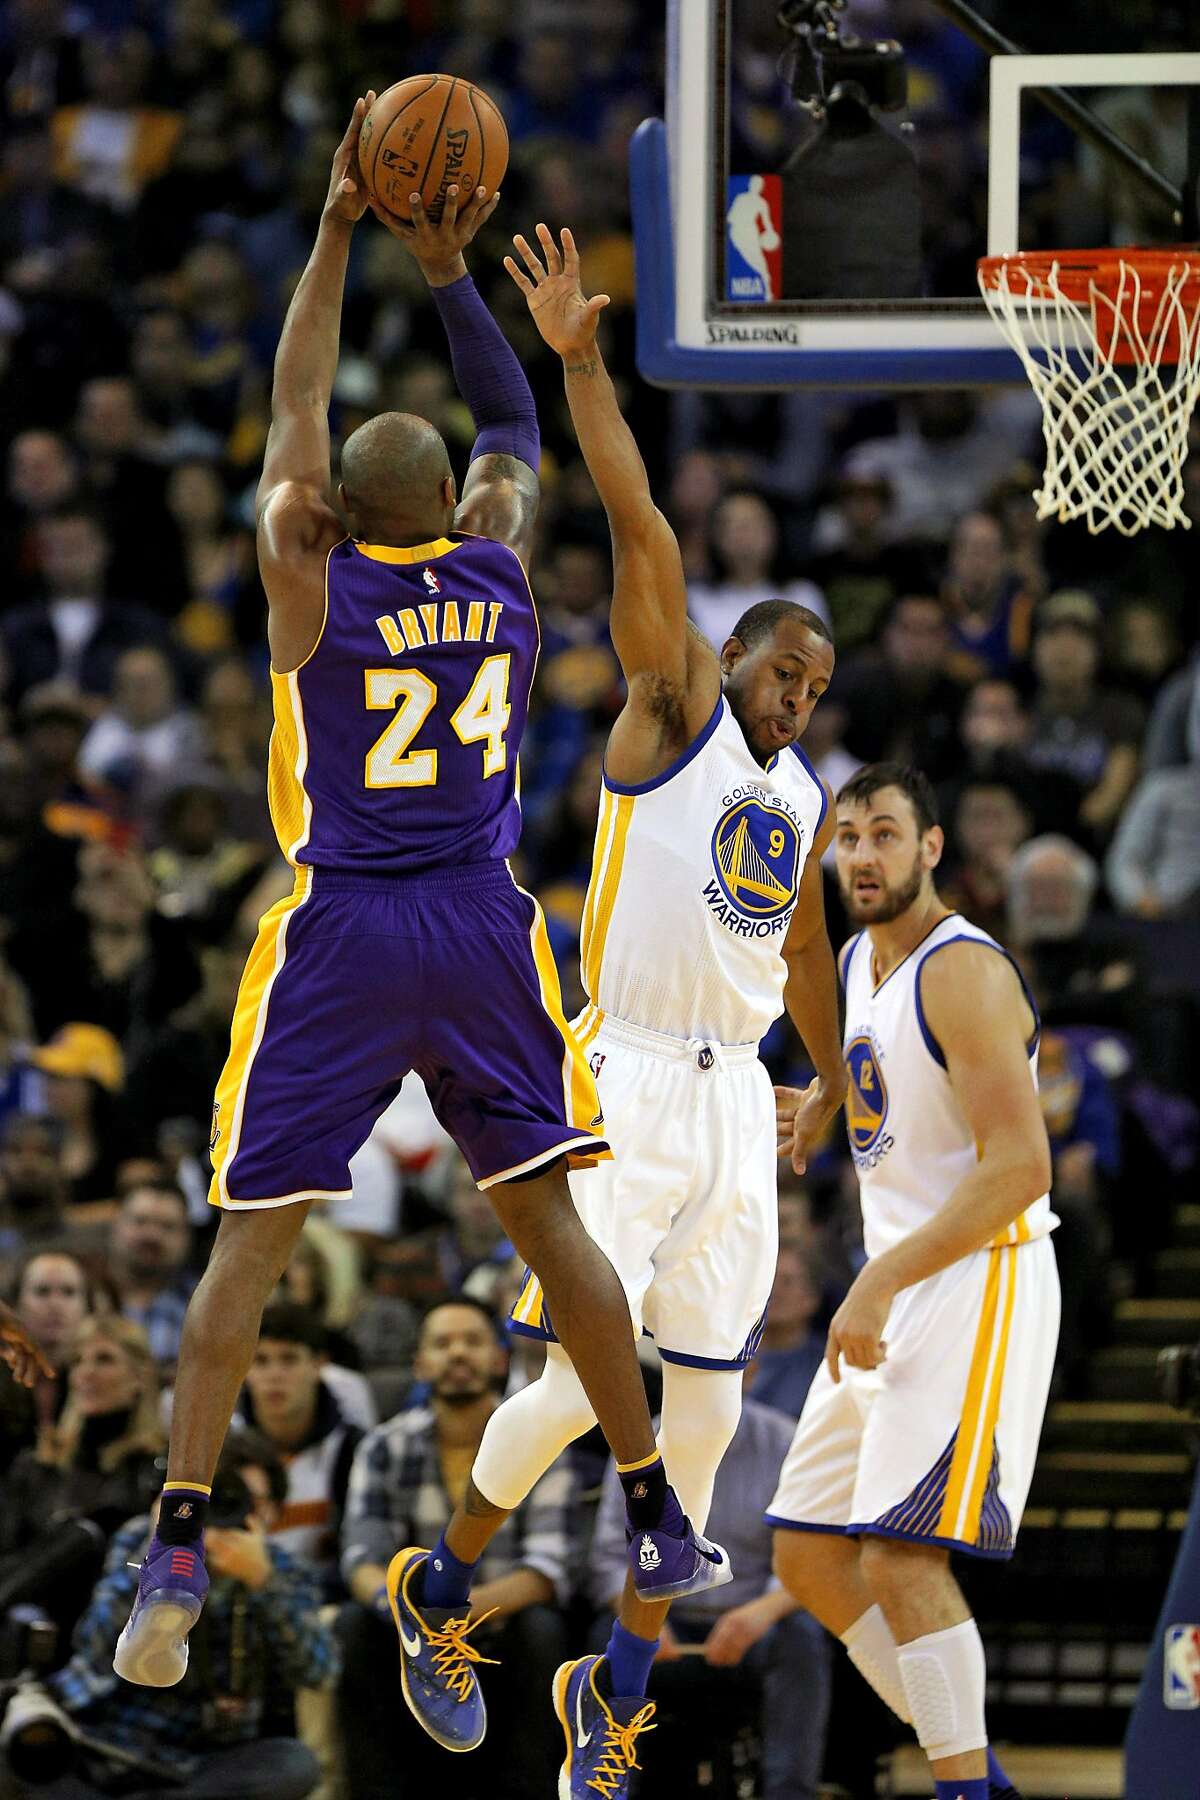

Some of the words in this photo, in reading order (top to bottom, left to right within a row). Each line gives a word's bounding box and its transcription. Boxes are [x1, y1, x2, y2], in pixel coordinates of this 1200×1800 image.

[425, 128, 469, 224] SPALDIN
[731, 277, 763, 295] NBA
[705, 323, 799, 346] SPALDING
[375, 601, 504, 657] BRYANT
[364, 652, 511, 789] 24
[722, 784, 767, 807] GOLDEN
[767, 829, 785, 858] 9
[702, 879, 793, 938] WARRIORS
